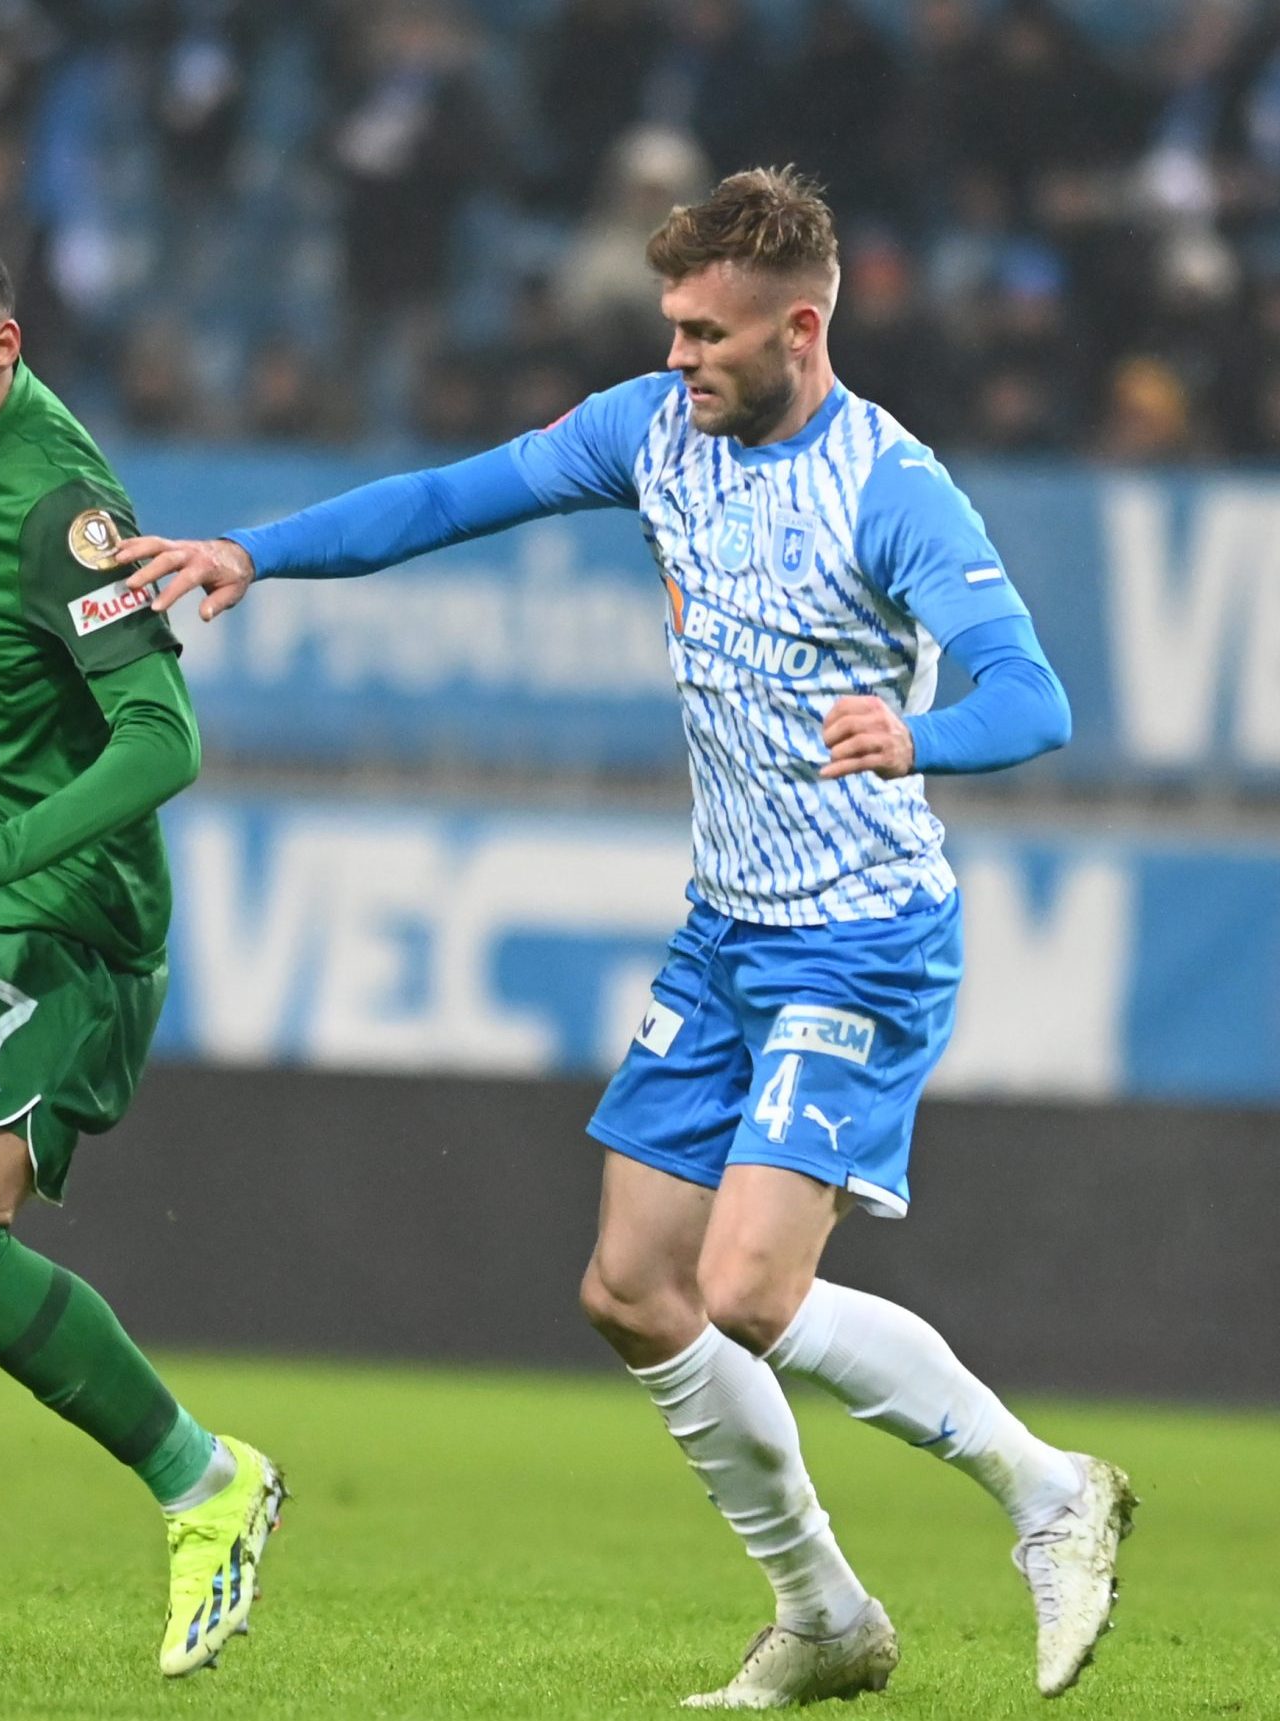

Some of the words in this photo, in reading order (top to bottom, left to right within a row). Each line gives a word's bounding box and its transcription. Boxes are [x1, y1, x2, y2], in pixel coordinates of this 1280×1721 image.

[721, 519, 749, 552] 75
[683, 600, 818, 678] BETANO
[772, 1015, 869, 1054] ECTRUM
[754, 1053, 804, 1144] 4
